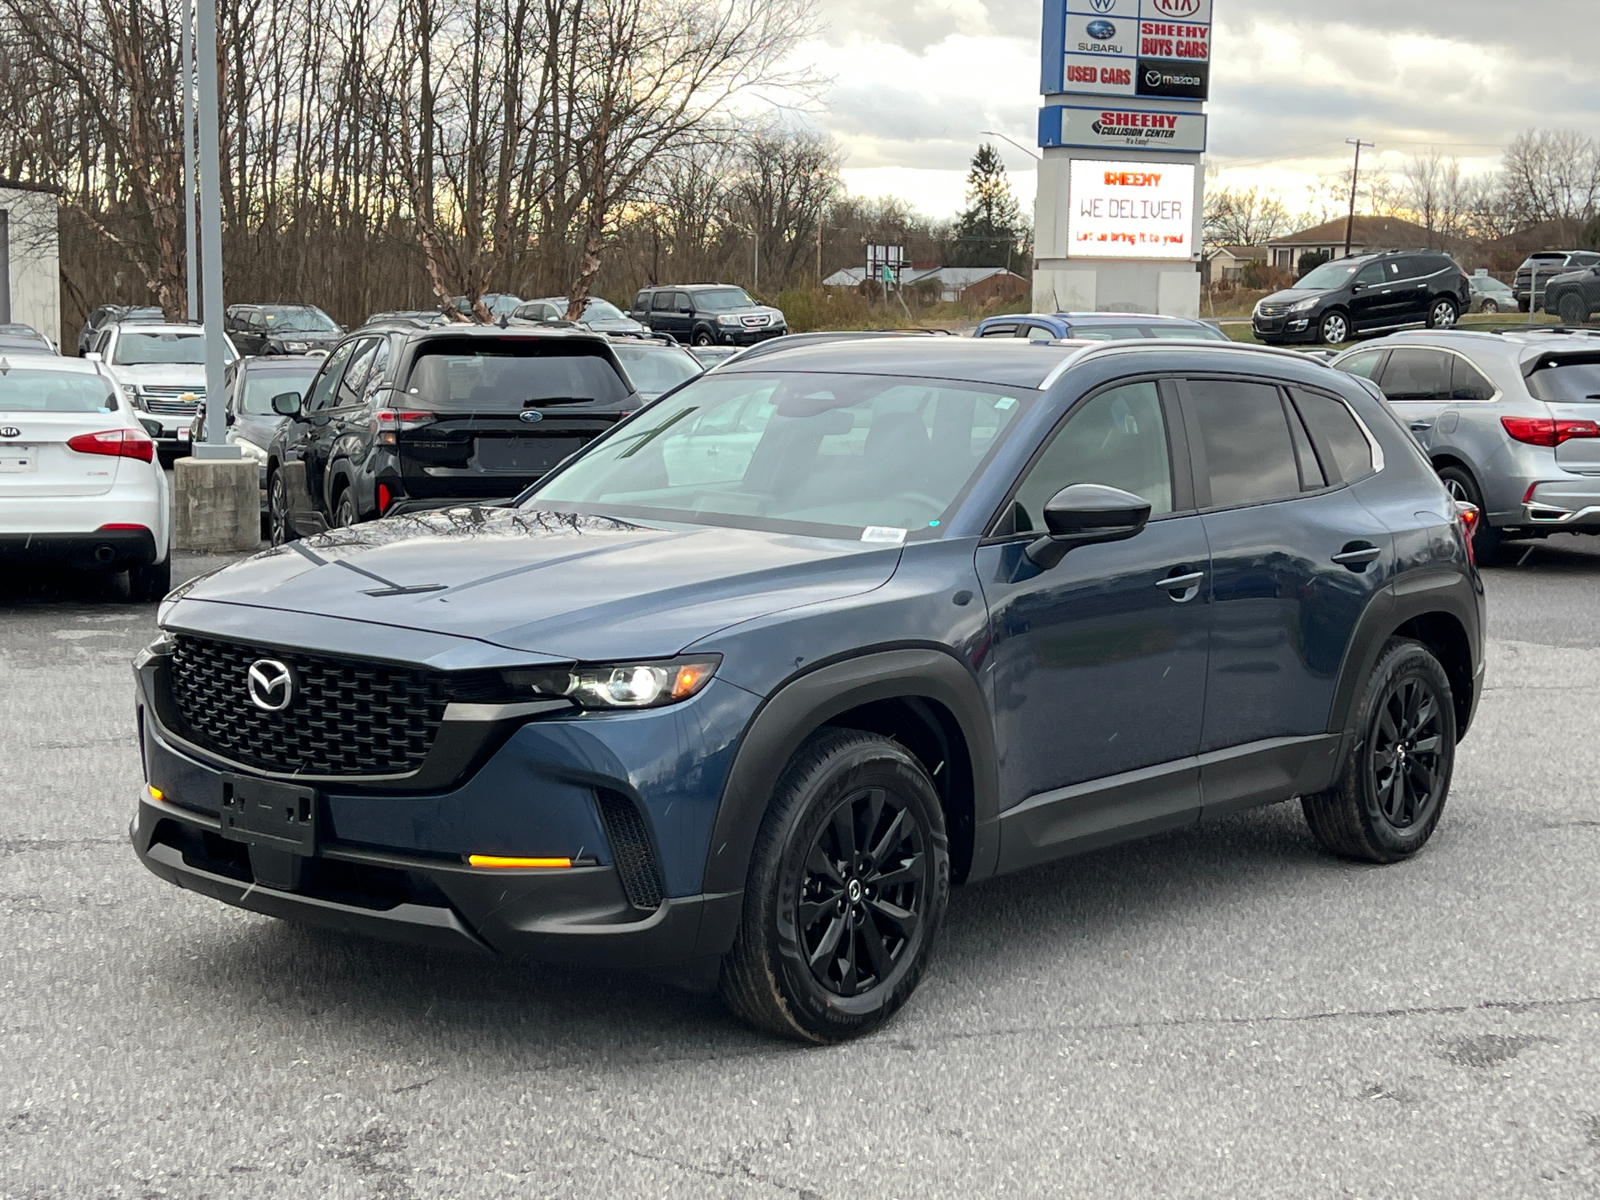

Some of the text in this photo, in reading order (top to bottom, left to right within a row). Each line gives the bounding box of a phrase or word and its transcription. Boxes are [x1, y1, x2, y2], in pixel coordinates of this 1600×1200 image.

[1141, 23, 1208, 38] SHEEHY
[1078, 42, 1123, 53] SUBARU
[1141, 37, 1208, 59] BUYS CARS
[1067, 65, 1131, 85] USED CARS
[1101, 112, 1177, 128] SHEEHY
[1101, 126, 1175, 139] COLLISION CENTER
[1104, 171, 1162, 187] SHEEHY
[1081, 198, 1182, 220] WE DELIVER
[1, 428, 18, 436] KIA
